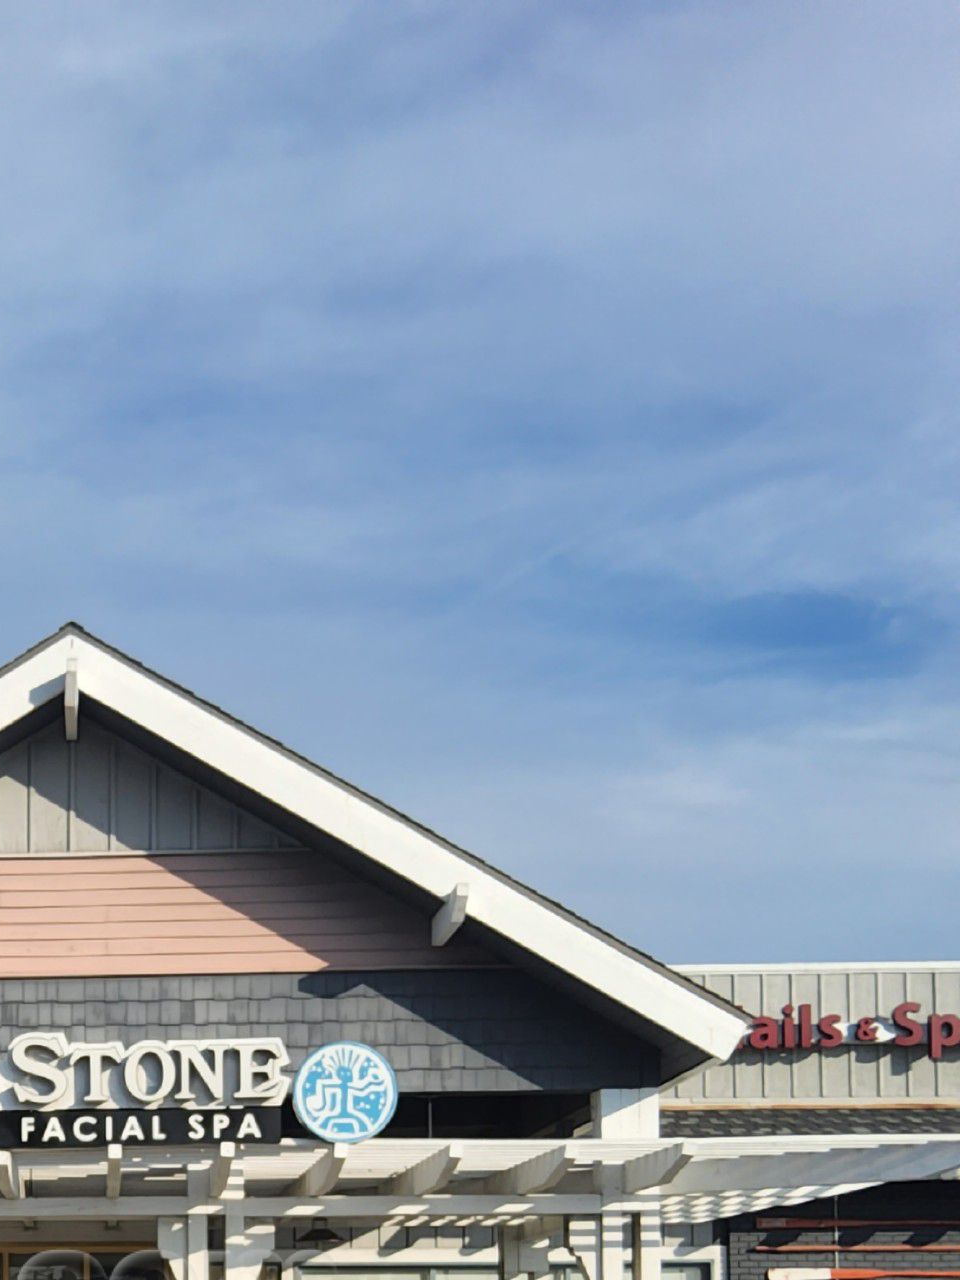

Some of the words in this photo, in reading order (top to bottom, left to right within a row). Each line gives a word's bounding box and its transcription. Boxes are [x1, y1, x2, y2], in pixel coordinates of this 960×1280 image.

[740, 1003, 842, 1049] ails
[856, 1017, 878, 1041] &
[10, 1034, 285, 1103] STONE
[20, 1115, 167, 1142] FACIAL
[188, 1113, 262, 1140] SPA
